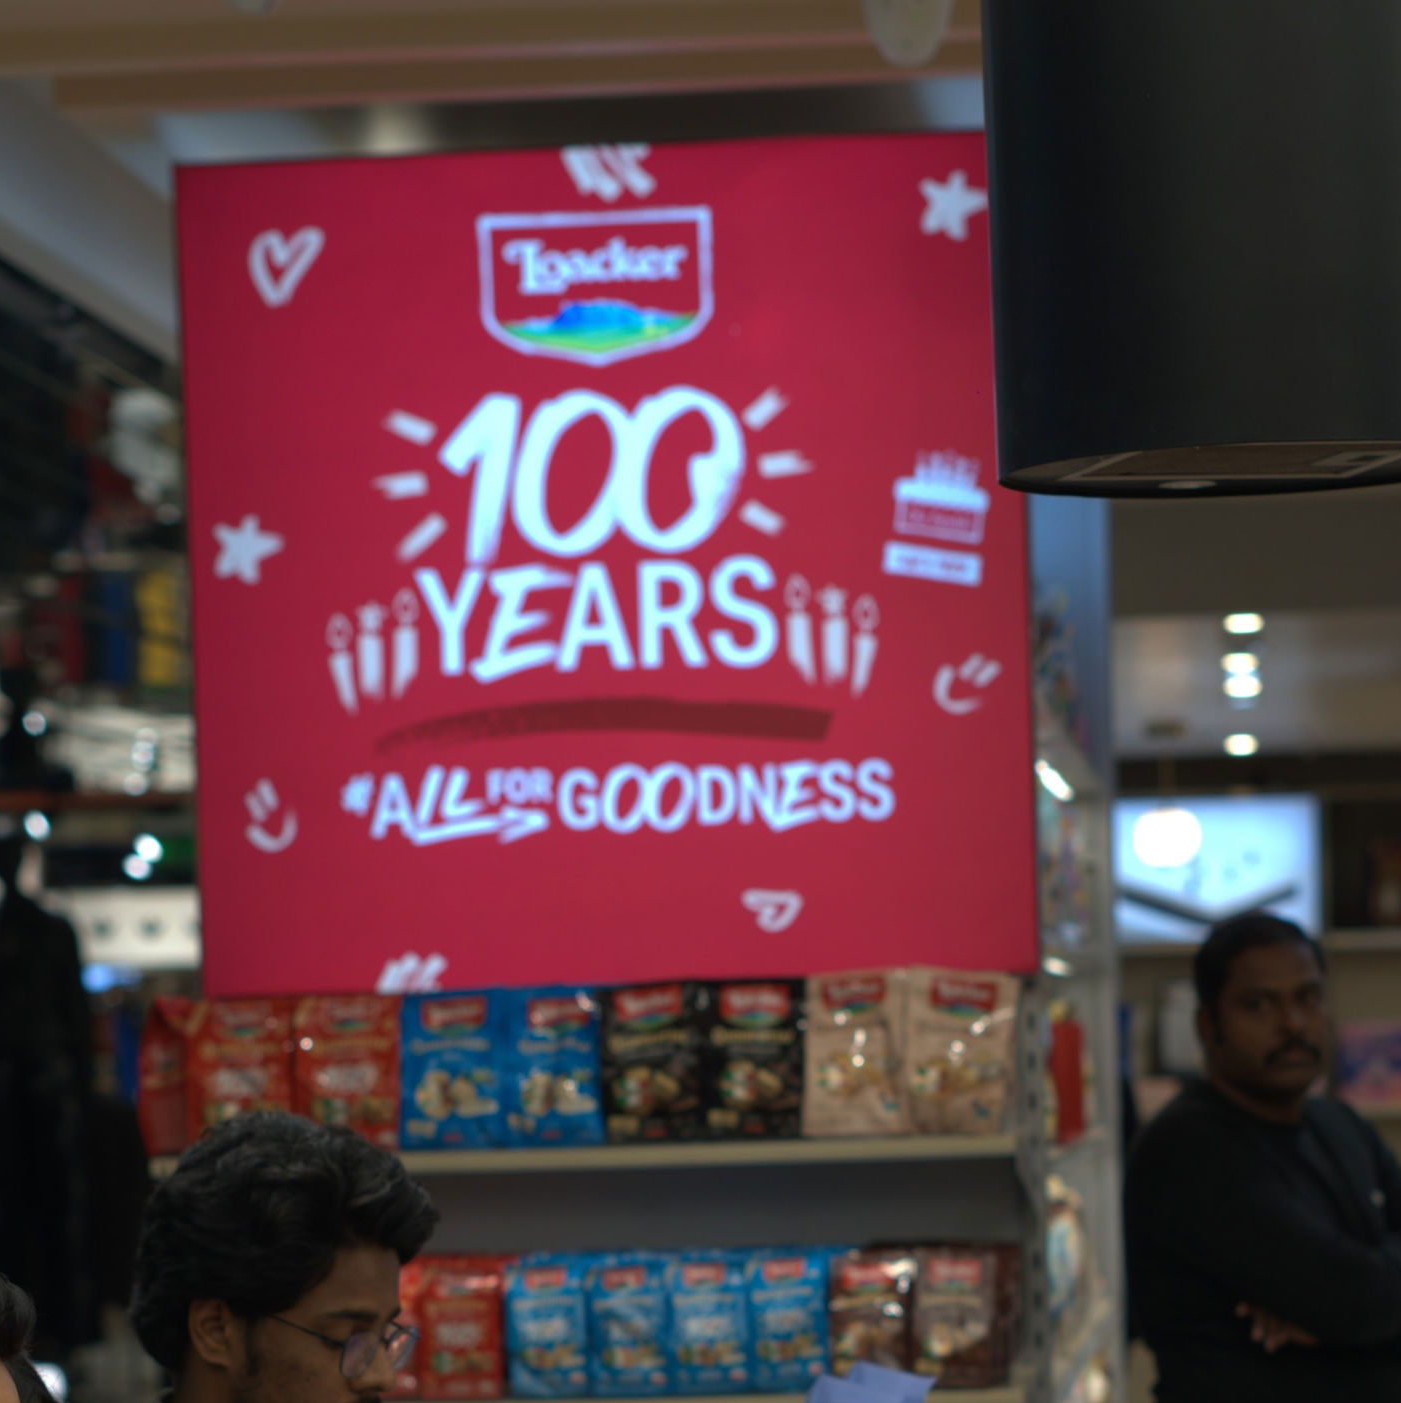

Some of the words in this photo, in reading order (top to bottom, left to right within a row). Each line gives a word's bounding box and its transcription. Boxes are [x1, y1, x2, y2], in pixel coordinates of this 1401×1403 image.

[503, 236, 689, 294] Loacker
[440, 386, 746, 567] 100
[414, 555, 779, 683] YEARS
[485, 767, 554, 805] FOR
[558, 759, 897, 833] GOODNESS
